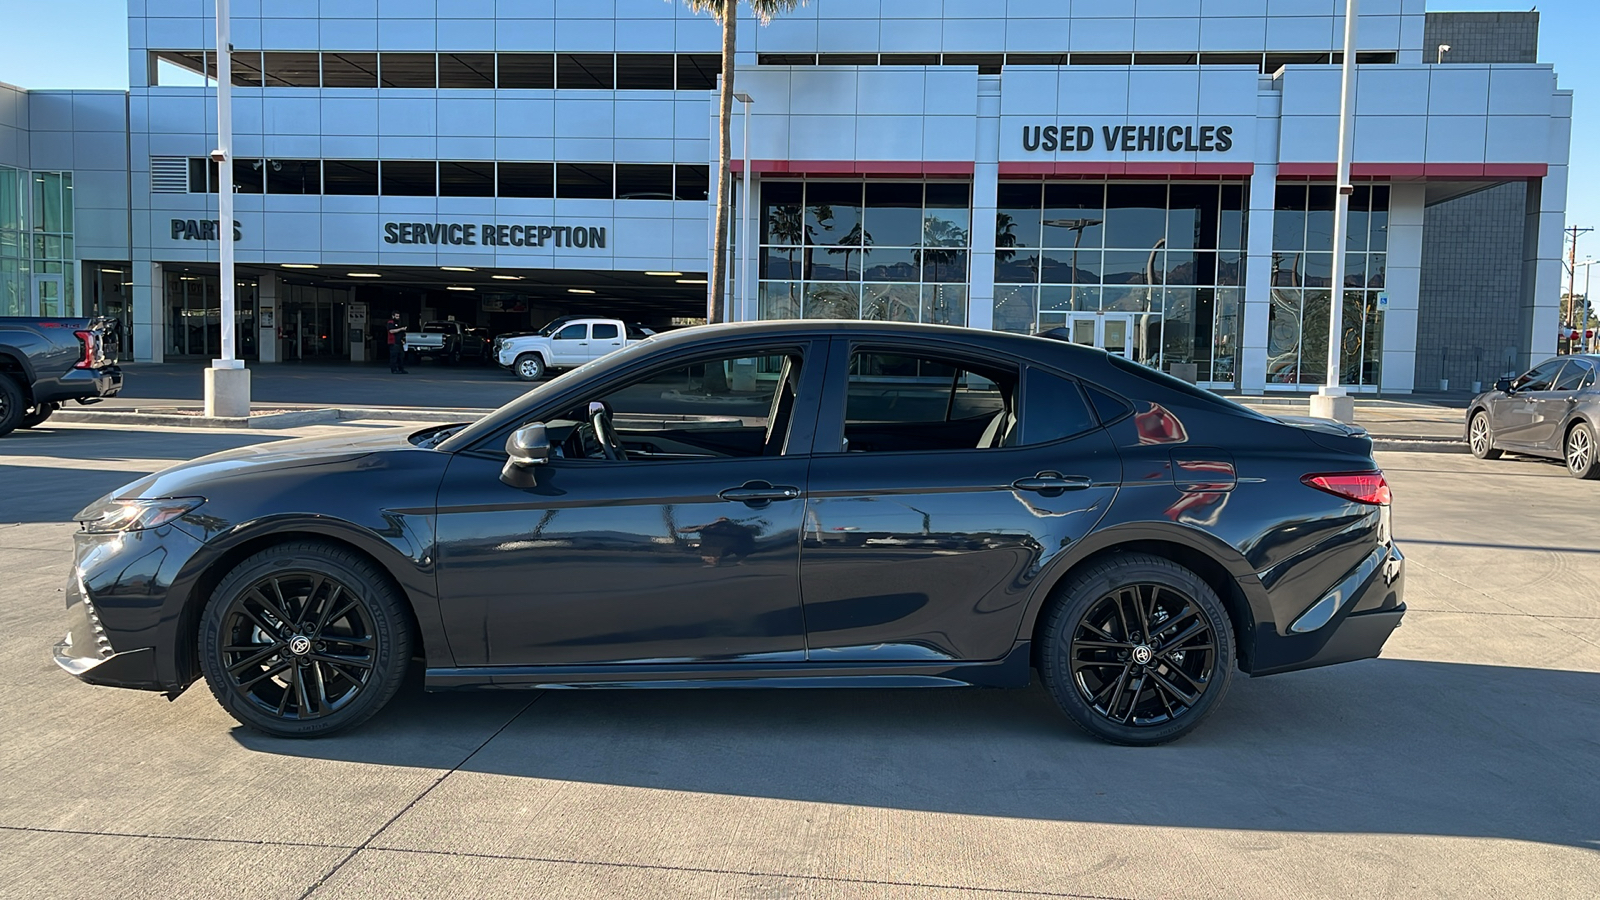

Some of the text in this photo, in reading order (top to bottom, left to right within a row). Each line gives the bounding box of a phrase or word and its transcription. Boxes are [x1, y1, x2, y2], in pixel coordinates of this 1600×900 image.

[1023, 126, 1233, 151] USED VEHICLES
[384, 223, 605, 248] SERVICE RECEPTION
[370, 604, 389, 661] ASSURANCE
